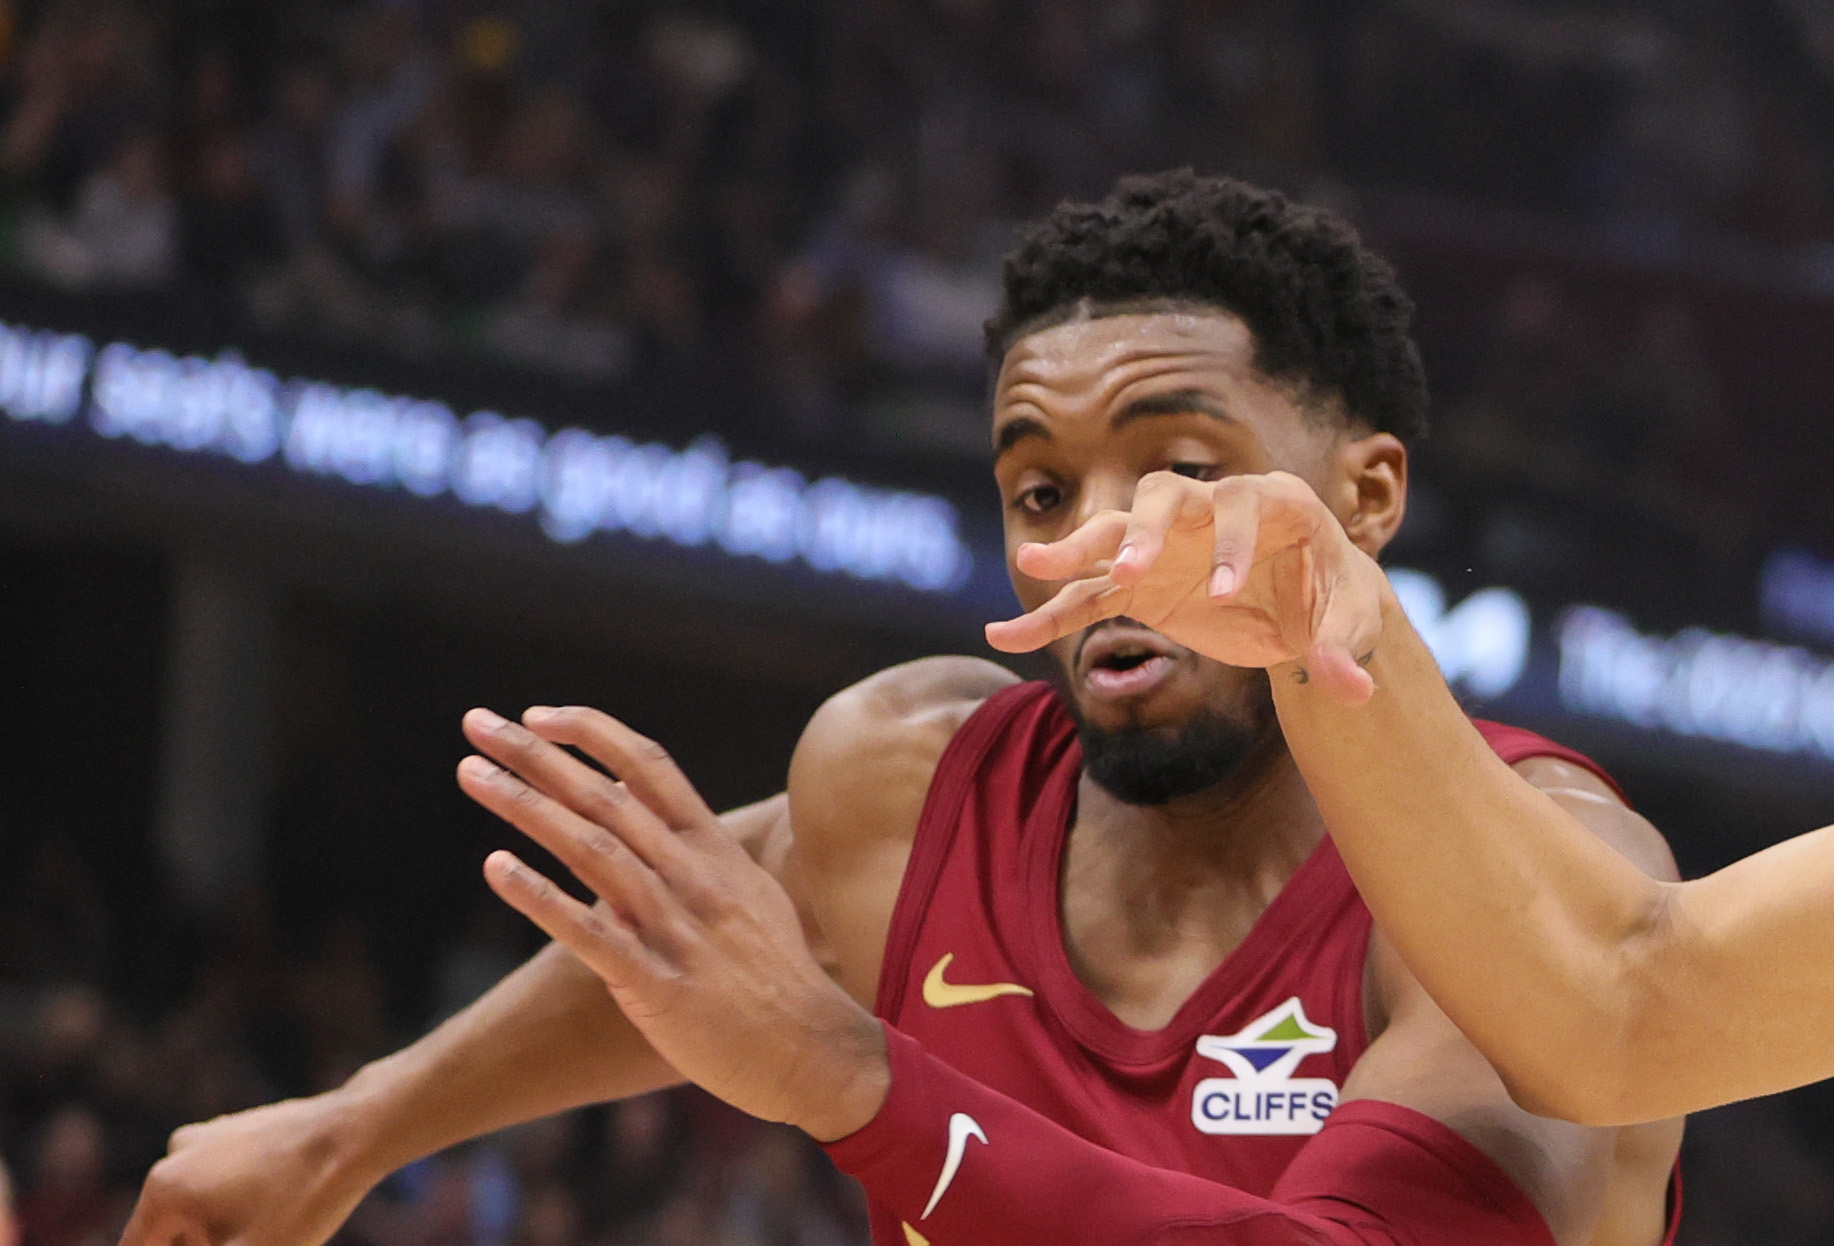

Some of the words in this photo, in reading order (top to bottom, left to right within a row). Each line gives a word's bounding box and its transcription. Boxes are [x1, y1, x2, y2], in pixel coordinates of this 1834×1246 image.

[92, 342, 281, 462] seats
[283, 378, 460, 496] were
[453, 410, 546, 513] as
[541, 427, 730, 544] good
[713, 460, 807, 562] as
[1202, 1092, 1334, 1120] CLIFFS
